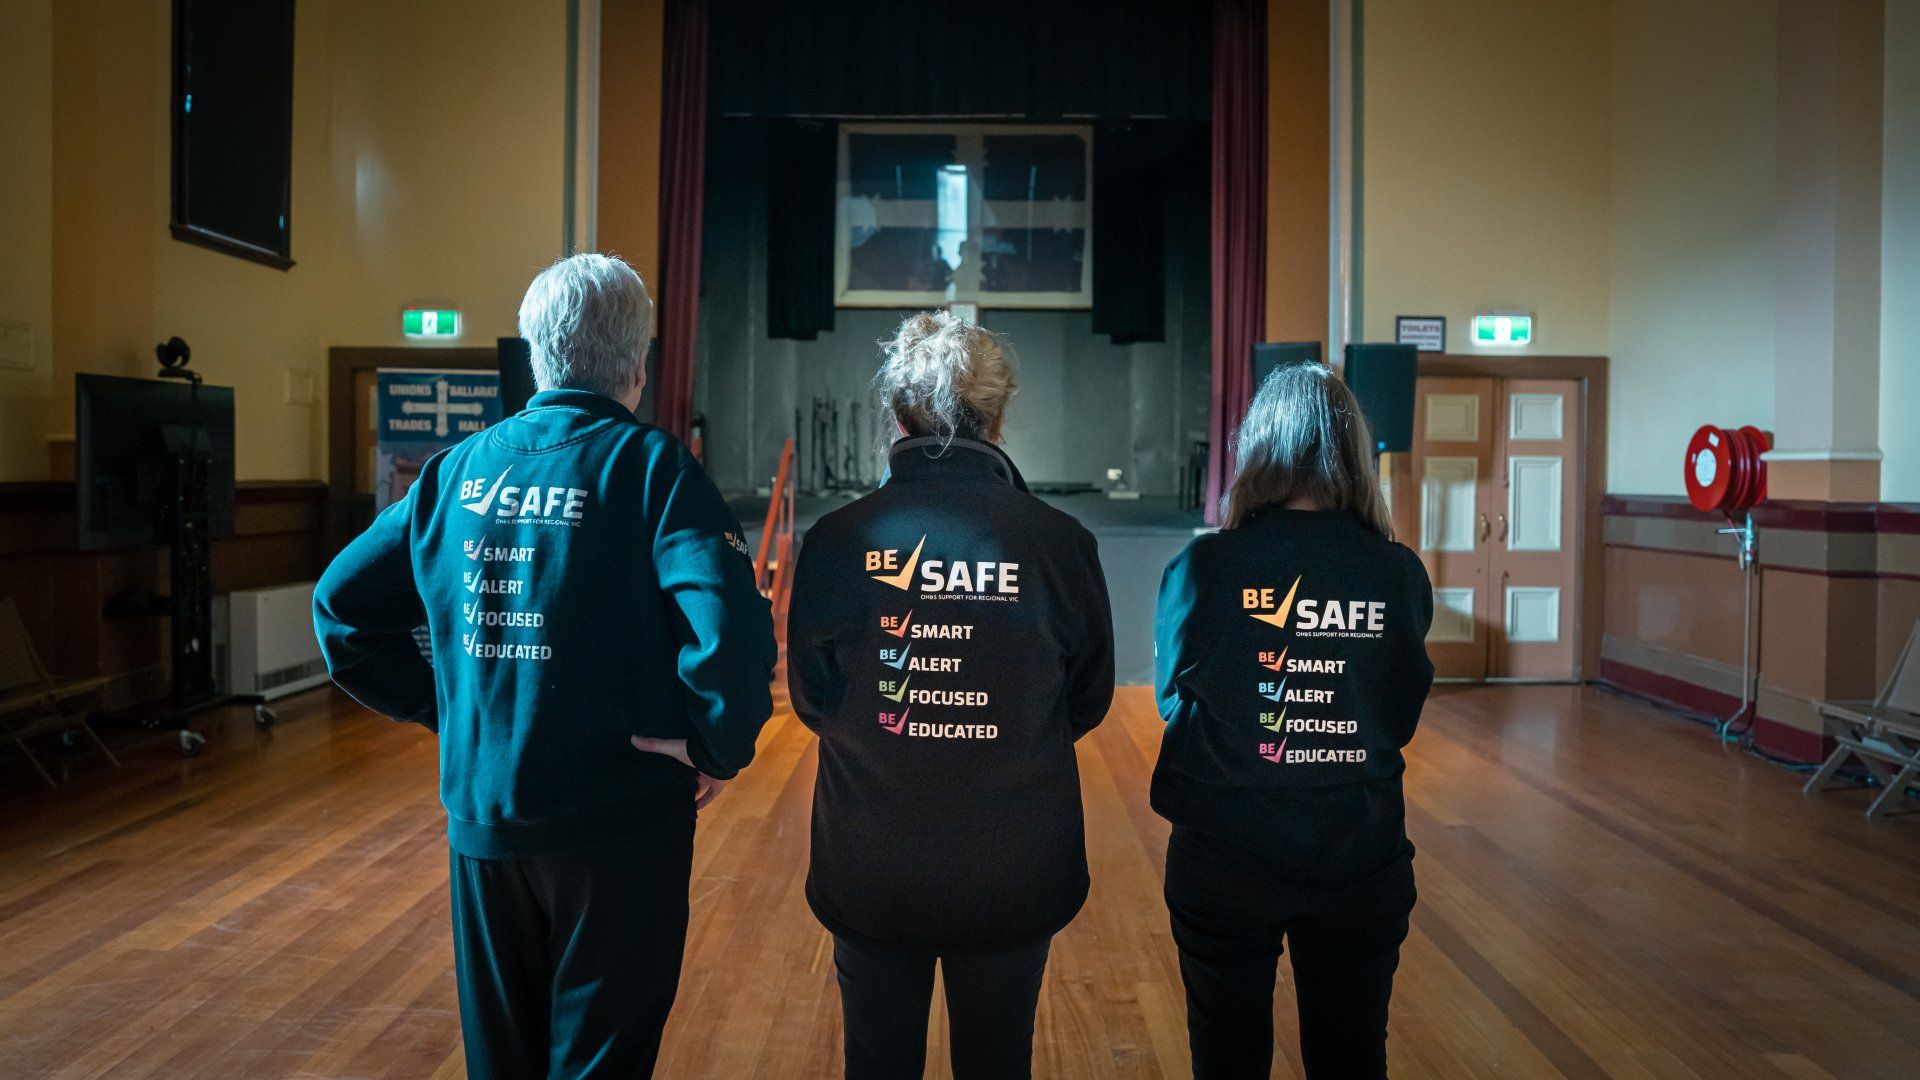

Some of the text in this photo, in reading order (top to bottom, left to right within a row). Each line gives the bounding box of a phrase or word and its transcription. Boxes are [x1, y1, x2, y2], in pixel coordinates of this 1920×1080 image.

[389, 385, 497, 397] UNIONS BALLARAT
[389, 420, 485, 431] TRADES HALL
[461, 478, 588, 519] BE SAFE
[463, 540, 535, 562] BE SMART
[865, 549, 1020, 593] BE SAFE
[463, 571, 524, 594] BE ALERT
[477, 611, 545, 628] FOCUSED
[1242, 588, 1386, 631] BE SAFE
[880, 616, 974, 640] BE SMART
[475, 643, 552, 660] EDUCATED
[879, 649, 962, 672] BE ALERT
[1258, 652, 1346, 674] BE SMART
[878, 681, 989, 706] BE FOCUSED
[1258, 682, 1335, 704] BE ALERT
[878, 713, 998, 739] BE EDUCATED
[1259, 713, 1358, 734] BE FOCUSED
[1259, 743, 1367, 764] BE EDUCATED
